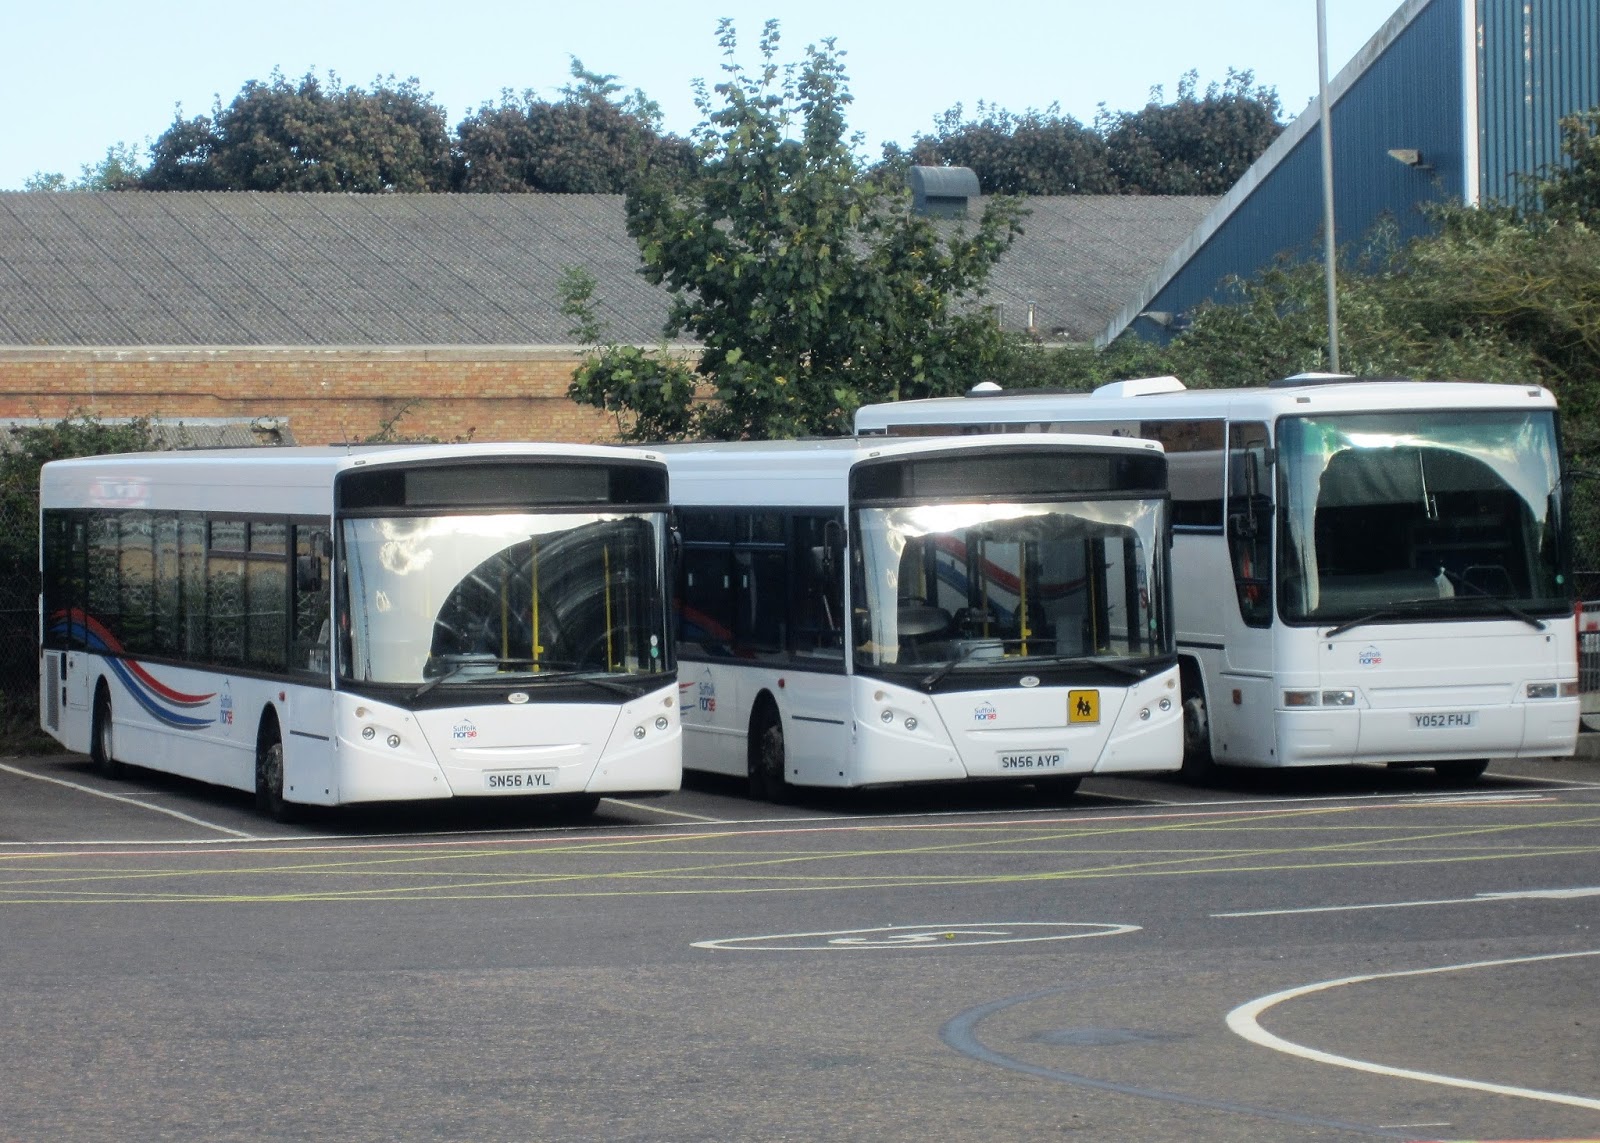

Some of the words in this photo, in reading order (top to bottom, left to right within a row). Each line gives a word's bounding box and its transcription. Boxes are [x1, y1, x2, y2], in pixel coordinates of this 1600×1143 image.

[1415, 715, 1445, 727] YO52
[1448, 714, 1471, 726] FHJ
[453, 724, 477, 732] Suffolk
[1002, 756, 1033, 768] SN56
[1037, 755, 1060, 767] AYP
[489, 774, 522, 788] SN56
[526, 774, 550, 787] AYL
